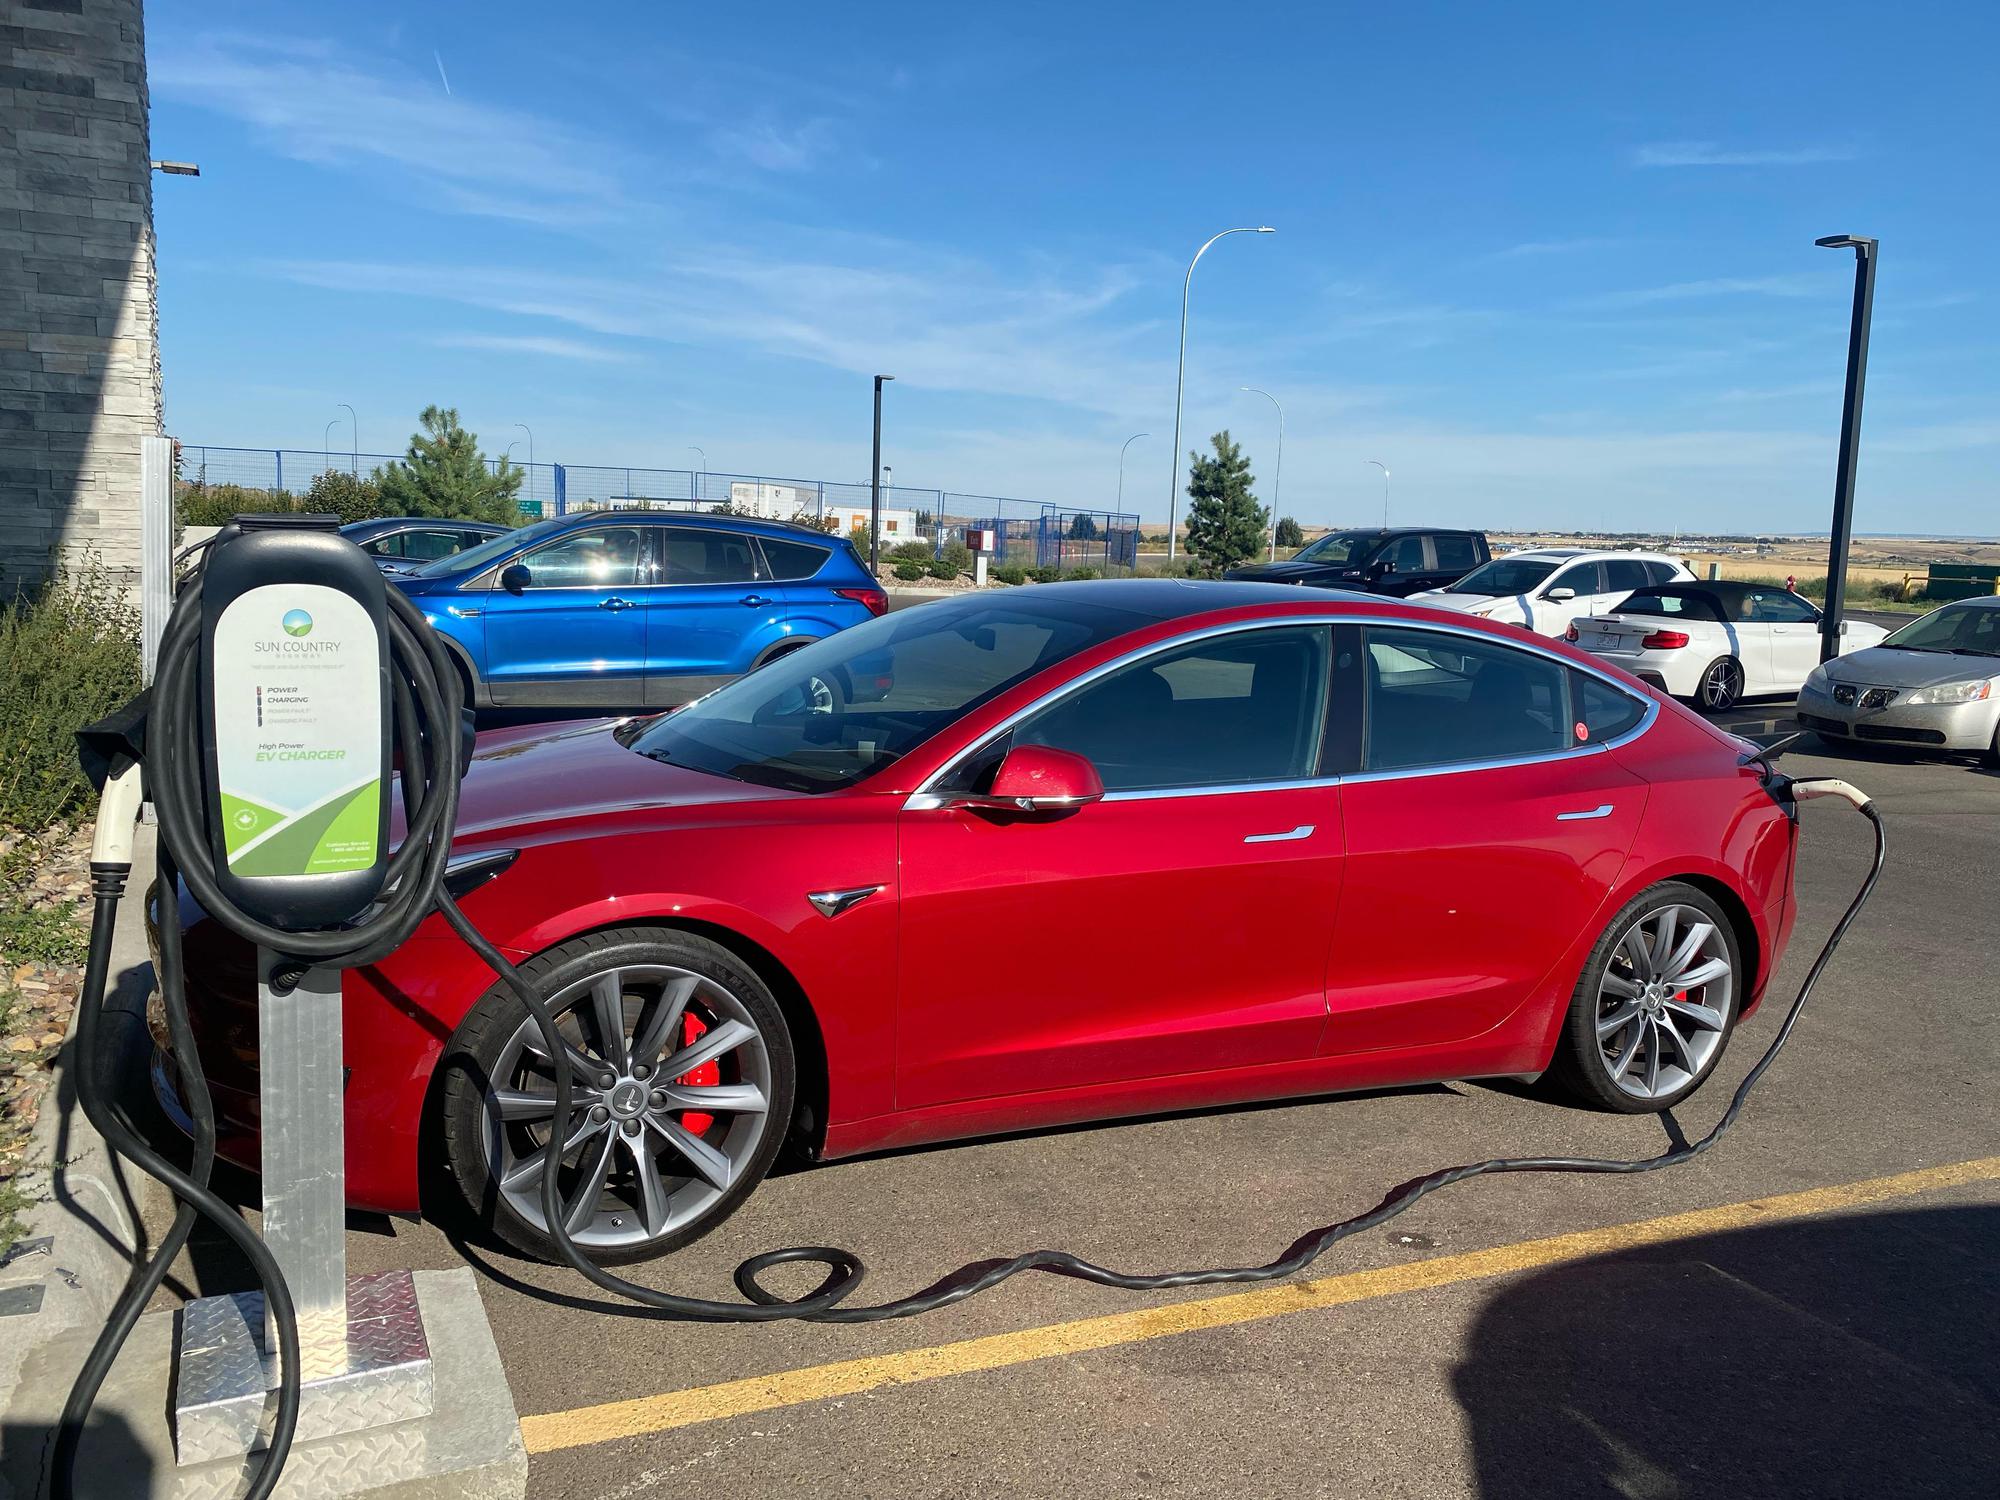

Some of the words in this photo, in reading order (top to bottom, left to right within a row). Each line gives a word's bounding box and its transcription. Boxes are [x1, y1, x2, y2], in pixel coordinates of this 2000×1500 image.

[254, 641, 280, 652] SUN
[283, 641, 341, 652] COUNTRY
[256, 752, 277, 761] EV
[279, 750, 346, 760] CHARGER
